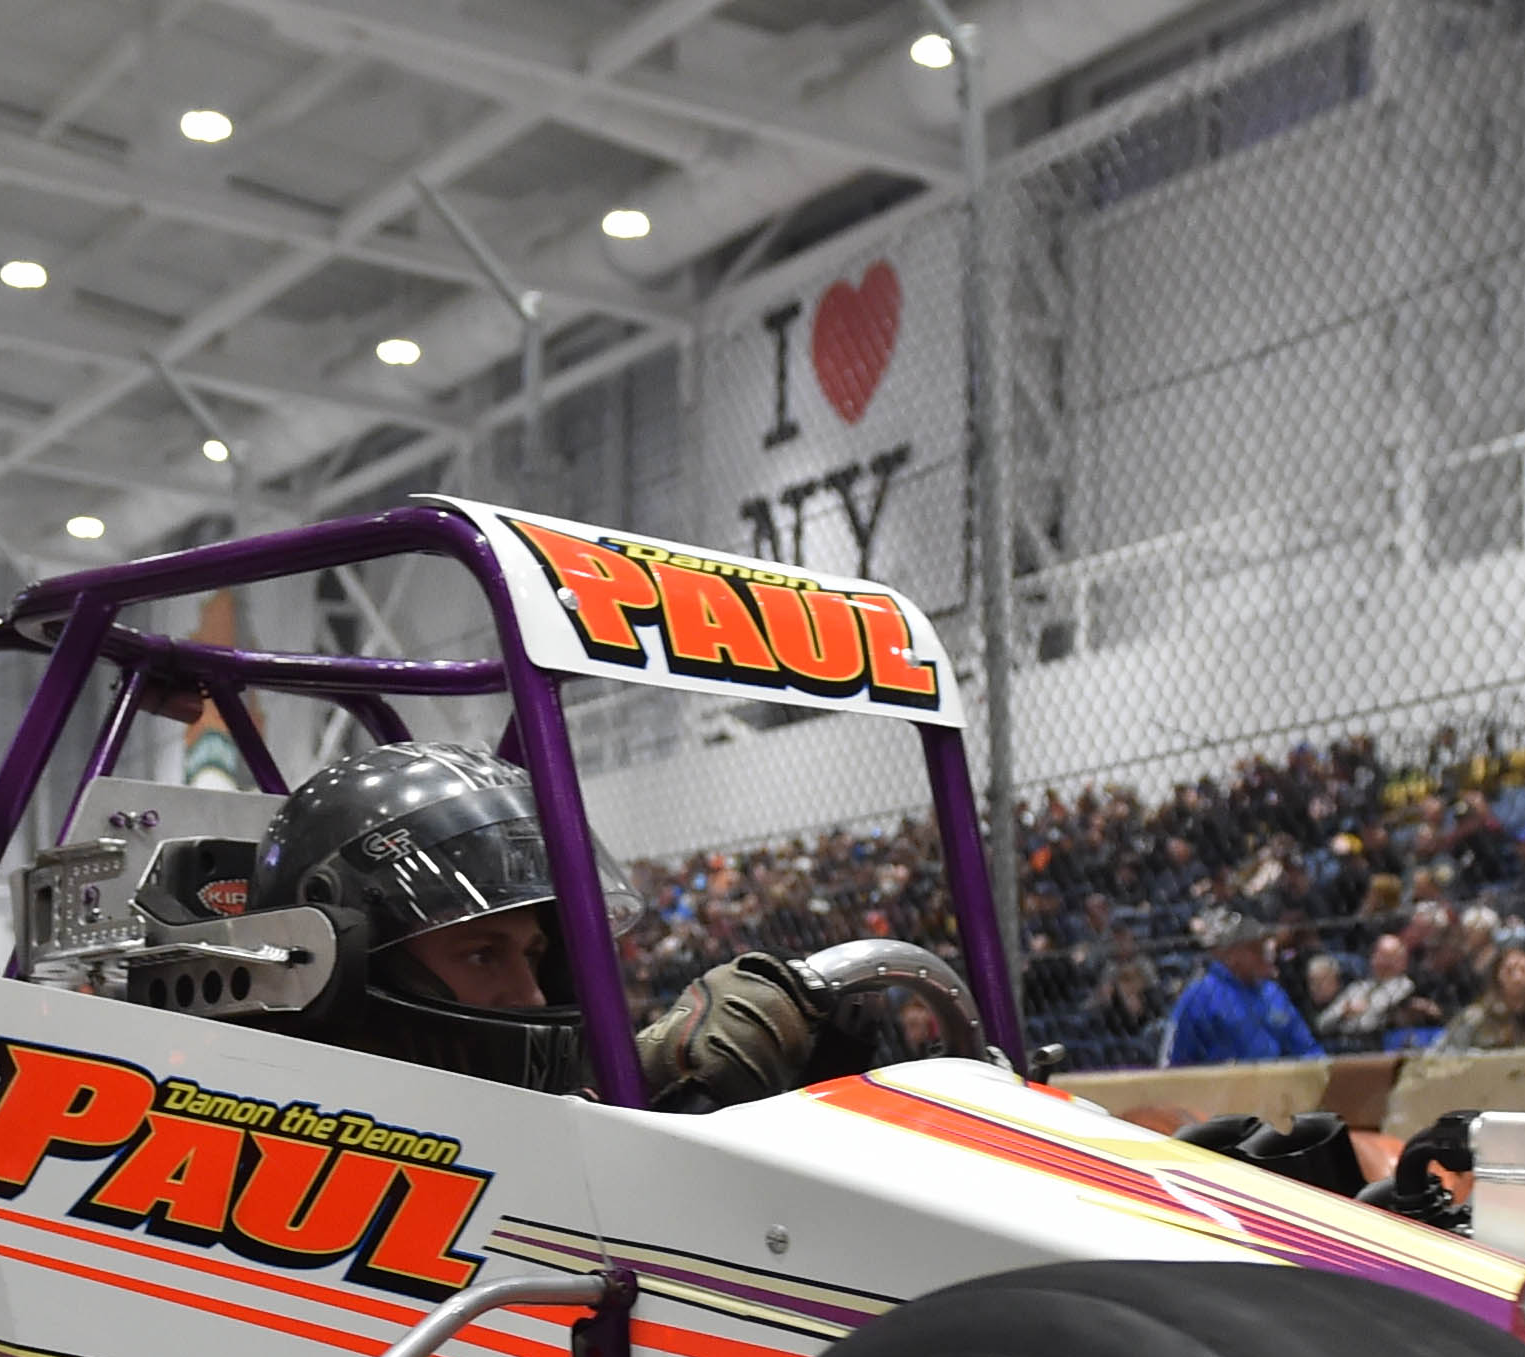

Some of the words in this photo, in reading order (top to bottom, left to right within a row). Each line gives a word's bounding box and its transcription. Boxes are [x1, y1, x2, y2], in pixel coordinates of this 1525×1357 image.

[763, 301, 802, 451] I
[498, 516, 940, 710] PAUL
[606, 538, 819, 592] Damon
[164, 1081, 276, 1128] Damon
[282, 1103, 335, 1140] the
[337, 1115, 459, 1165] Demon
